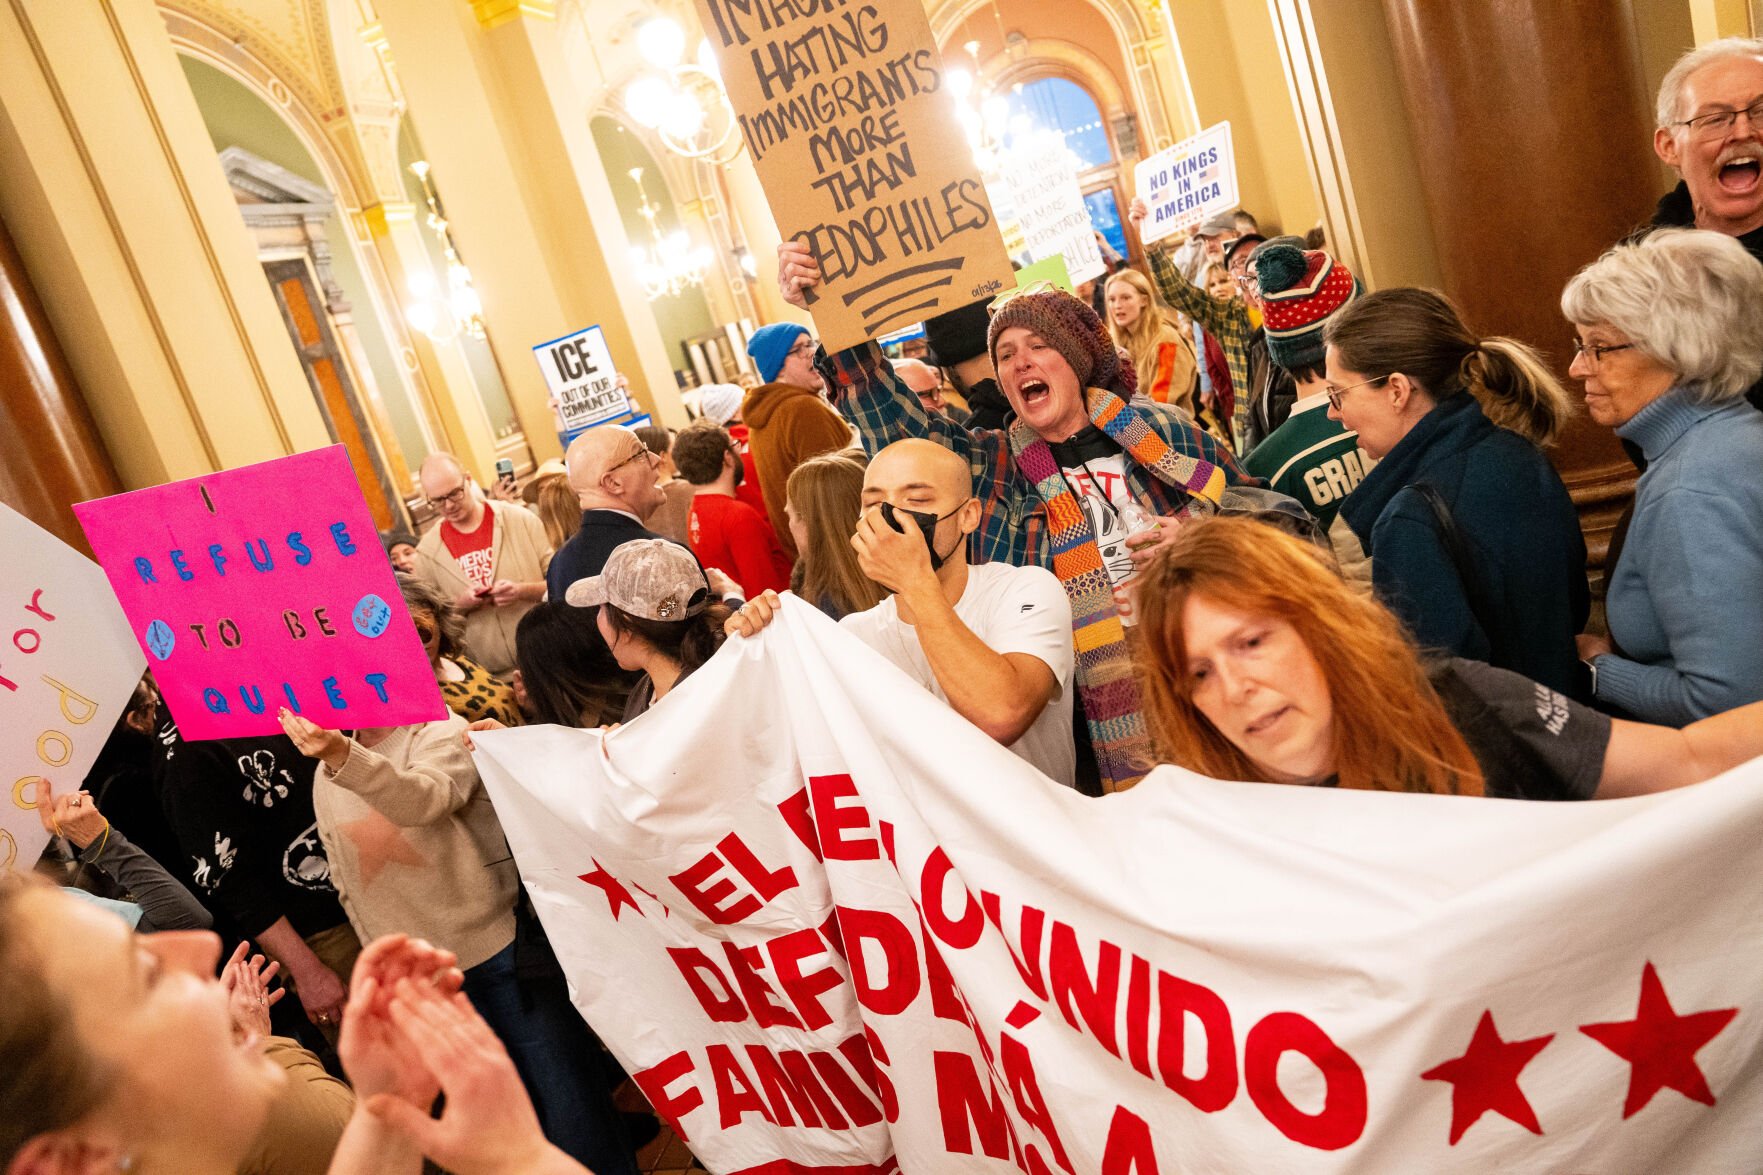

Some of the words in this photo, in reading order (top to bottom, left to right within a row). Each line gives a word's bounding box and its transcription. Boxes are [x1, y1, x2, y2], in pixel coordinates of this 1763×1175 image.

[751, 5, 888, 100] HATING
[809, 109, 906, 175] MORE
[811, 141, 917, 213] THAN
[1150, 170, 1168, 192] NO
[1173, 147, 1218, 180] KINGS
[1178, 177, 1191, 194] IN
[1155, 182, 1221, 223] AMERICA
[550, 337, 598, 382] ICE
[561, 388, 580, 404] OUT
[579, 383, 590, 398] OF
[591, 377, 611, 394] OUR
[562, 388, 622, 418] COMMUNITIES
[199, 484, 216, 515] I
[134, 521, 356, 584] REFUSE
[189, 617, 242, 651] TO
[282, 607, 337, 640] BE
[203, 673, 389, 715] QUIET
[669, 832, 799, 925] EL
